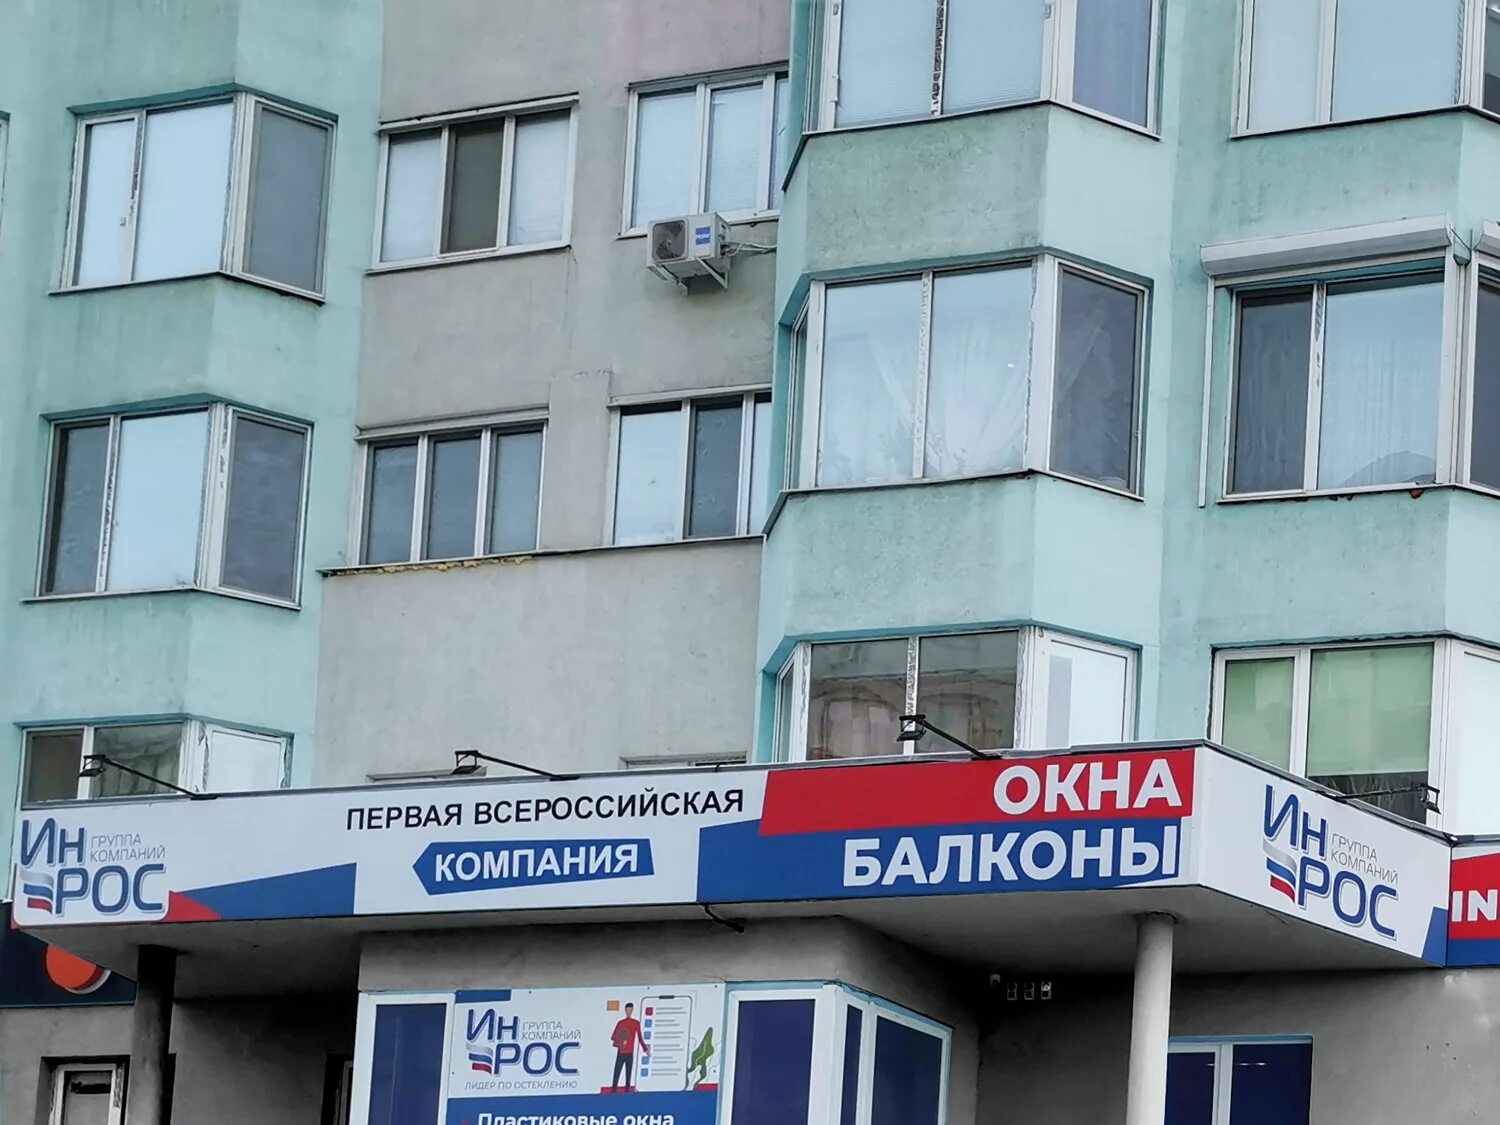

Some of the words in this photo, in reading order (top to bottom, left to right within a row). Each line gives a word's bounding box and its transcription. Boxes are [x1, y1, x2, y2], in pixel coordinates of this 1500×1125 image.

[993, 757, 1183, 815] ОКНА
[346, 803, 462, 831] ПЕРВАЯ
[474, 785, 744, 824] ВСЕРОССИЙСКАЯ
[1262, 784, 1328, 859] Ин
[20, 817, 86, 867] Ин
[90, 845, 166, 862] КОМПАНИЙ
[91, 832, 142, 848] ГРУППА
[842, 825, 1177, 888] БАЛКОНЫ
[1330, 832, 1378, 861] ГРУППА
[434, 844, 639, 883] КОМПАНИЯ
[1330, 847, 1398, 884] КОМПАНИЙ
[56, 863, 166, 916] РОС
[1297, 857, 1399, 940] РОС
[466, 1008, 518, 1041] Ин
[522, 1028, 582, 1041] КОМПАНИЙ
[523, 1021, 563, 1031] ГРУППА
[493, 1041, 580, 1076] РОС
[465, 1081, 496, 1091] ЛИДЕР
[497, 1081, 512, 1090] ПО
[514, 1080, 577, 1089] ОСТЕКЛЕНИЮ
